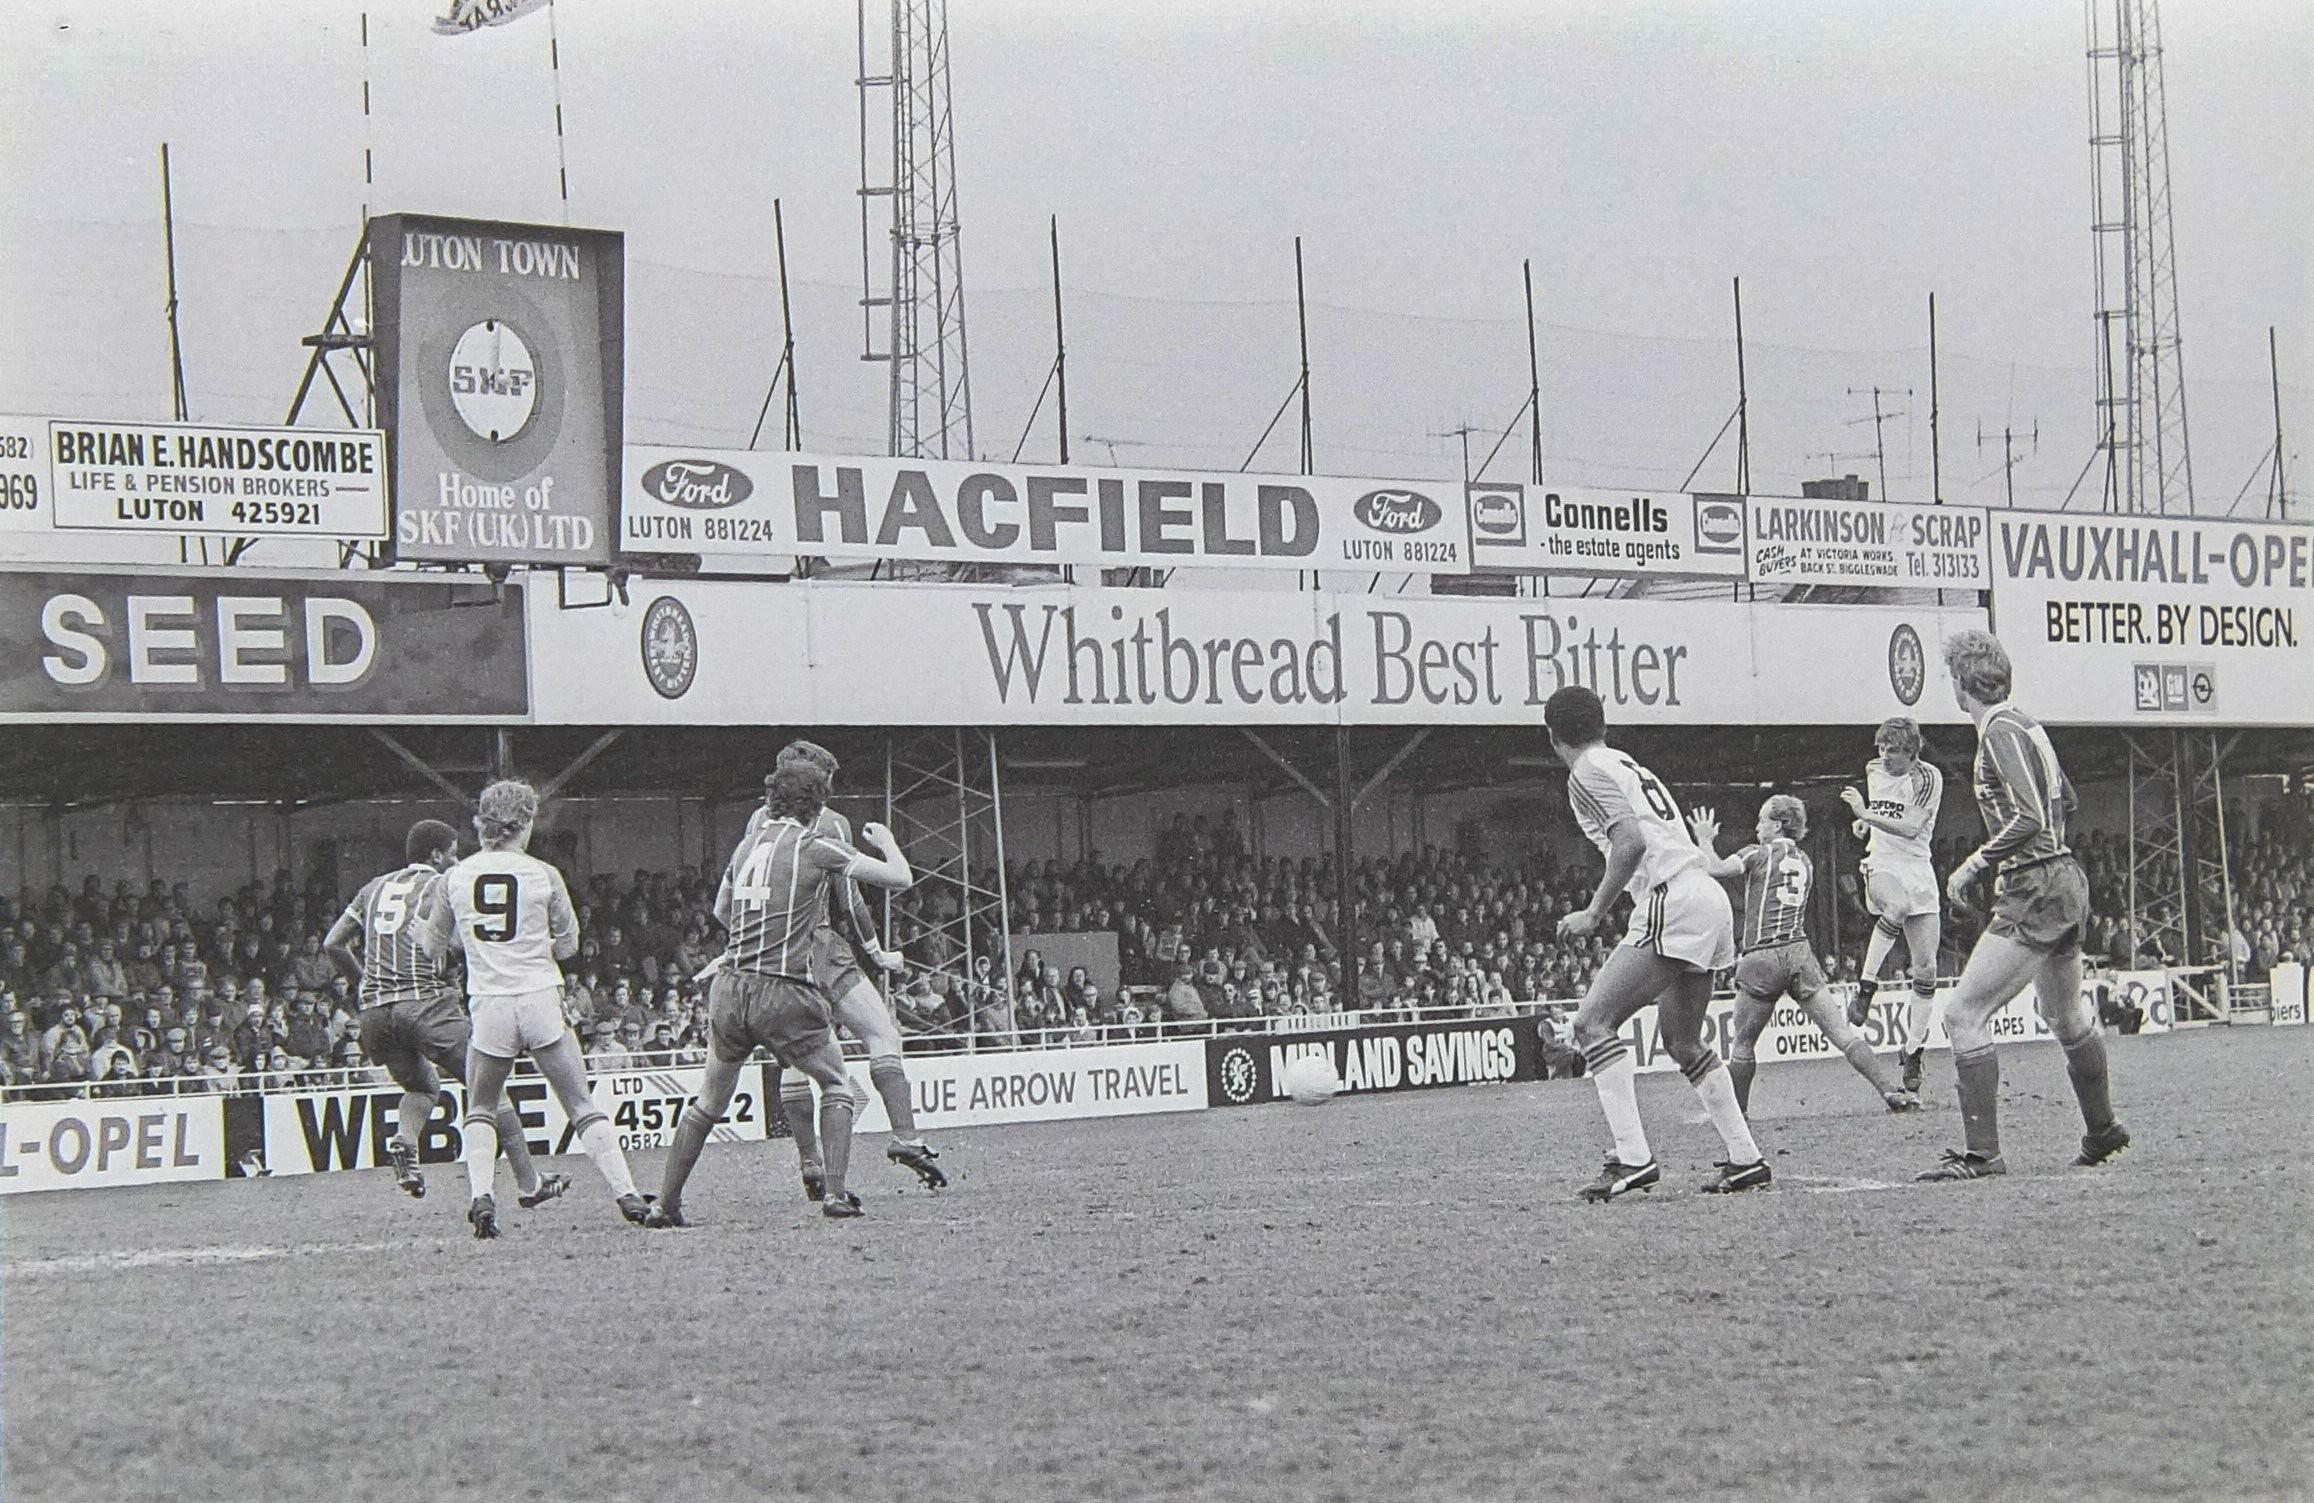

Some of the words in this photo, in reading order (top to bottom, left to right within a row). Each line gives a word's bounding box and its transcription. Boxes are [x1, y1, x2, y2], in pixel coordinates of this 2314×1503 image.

[493, 240, 580, 280] TOWN
[453, 365, 533, 396] SKF
[57, 431, 143, 466] BRIAN
[70, 472, 116, 492] LIFE
[125, 474, 137, 491] &
[146, 474, 235, 496] PENSION
[243, 478, 330, 498] BROKERS
[439, 473, 516, 510] Home
[525, 477, 553, 510] of
[659, 461, 732, 505] Ford
[117, 498, 203, 522] LUTON
[231, 501, 320, 525] 425921
[628, 516, 692, 541] LUTON
[704, 519, 773, 542] 881224
[792, 464, 1320, 557] HACFIELD
[1367, 493, 1425, 530] Ford
[1545, 493, 1668, 532] Connells
[1755, 506, 1885, 545] LARKINSON
[1911, 514, 1982, 548] SCRAP
[401, 511, 460, 545] SKF
[535, 516, 594, 551] LTD
[1549, 533, 1572, 556] the
[1576, 536, 1620, 558] estate
[1626, 541, 1680, 566] agents
[1343, 540, 1393, 561] LUTON
[1404, 542, 1457, 563] 881224
[1756, 545, 1784, 563] CASH
[1759, 555, 1796, 576] BUYERS
[1800, 548, 1811, 559] AT
[1817, 548, 1858, 560] VICTORIA
[1800, 562, 1823, 574] BACK
[1840, 563, 1898, 577] BIGGLESWADE
[1906, 552, 1929, 577] Tel.
[1933, 553, 1980, 578] 313133
[2001, 522, 2314, 588] VAUXHALL-OPE
[42, 593, 377, 686] SEED
[2157, 604, 2191, 645] BY
[2200, 605, 2297, 648] DESIGN.
[971, 602, 1347, 705] Whitbread
[1367, 611, 1502, 706] Best
[1519, 614, 1687, 706] Bitter
[734, 841, 771, 911] 4
[374, 881, 415, 935] 5
[472, 873, 520, 942] 9
[1776, 1033, 1829, 1055] OVENS
[1989, 1017, 2025, 1037] APES
[1406, 1028, 1516, 1086] SAVINGS
[612, 1077, 643, 1095] LTD
[969, 1071, 1076, 1111] ARROW
[1088, 1063, 1188, 1100] TRAVEL
[615, 1093, 753, 1131] 4572
